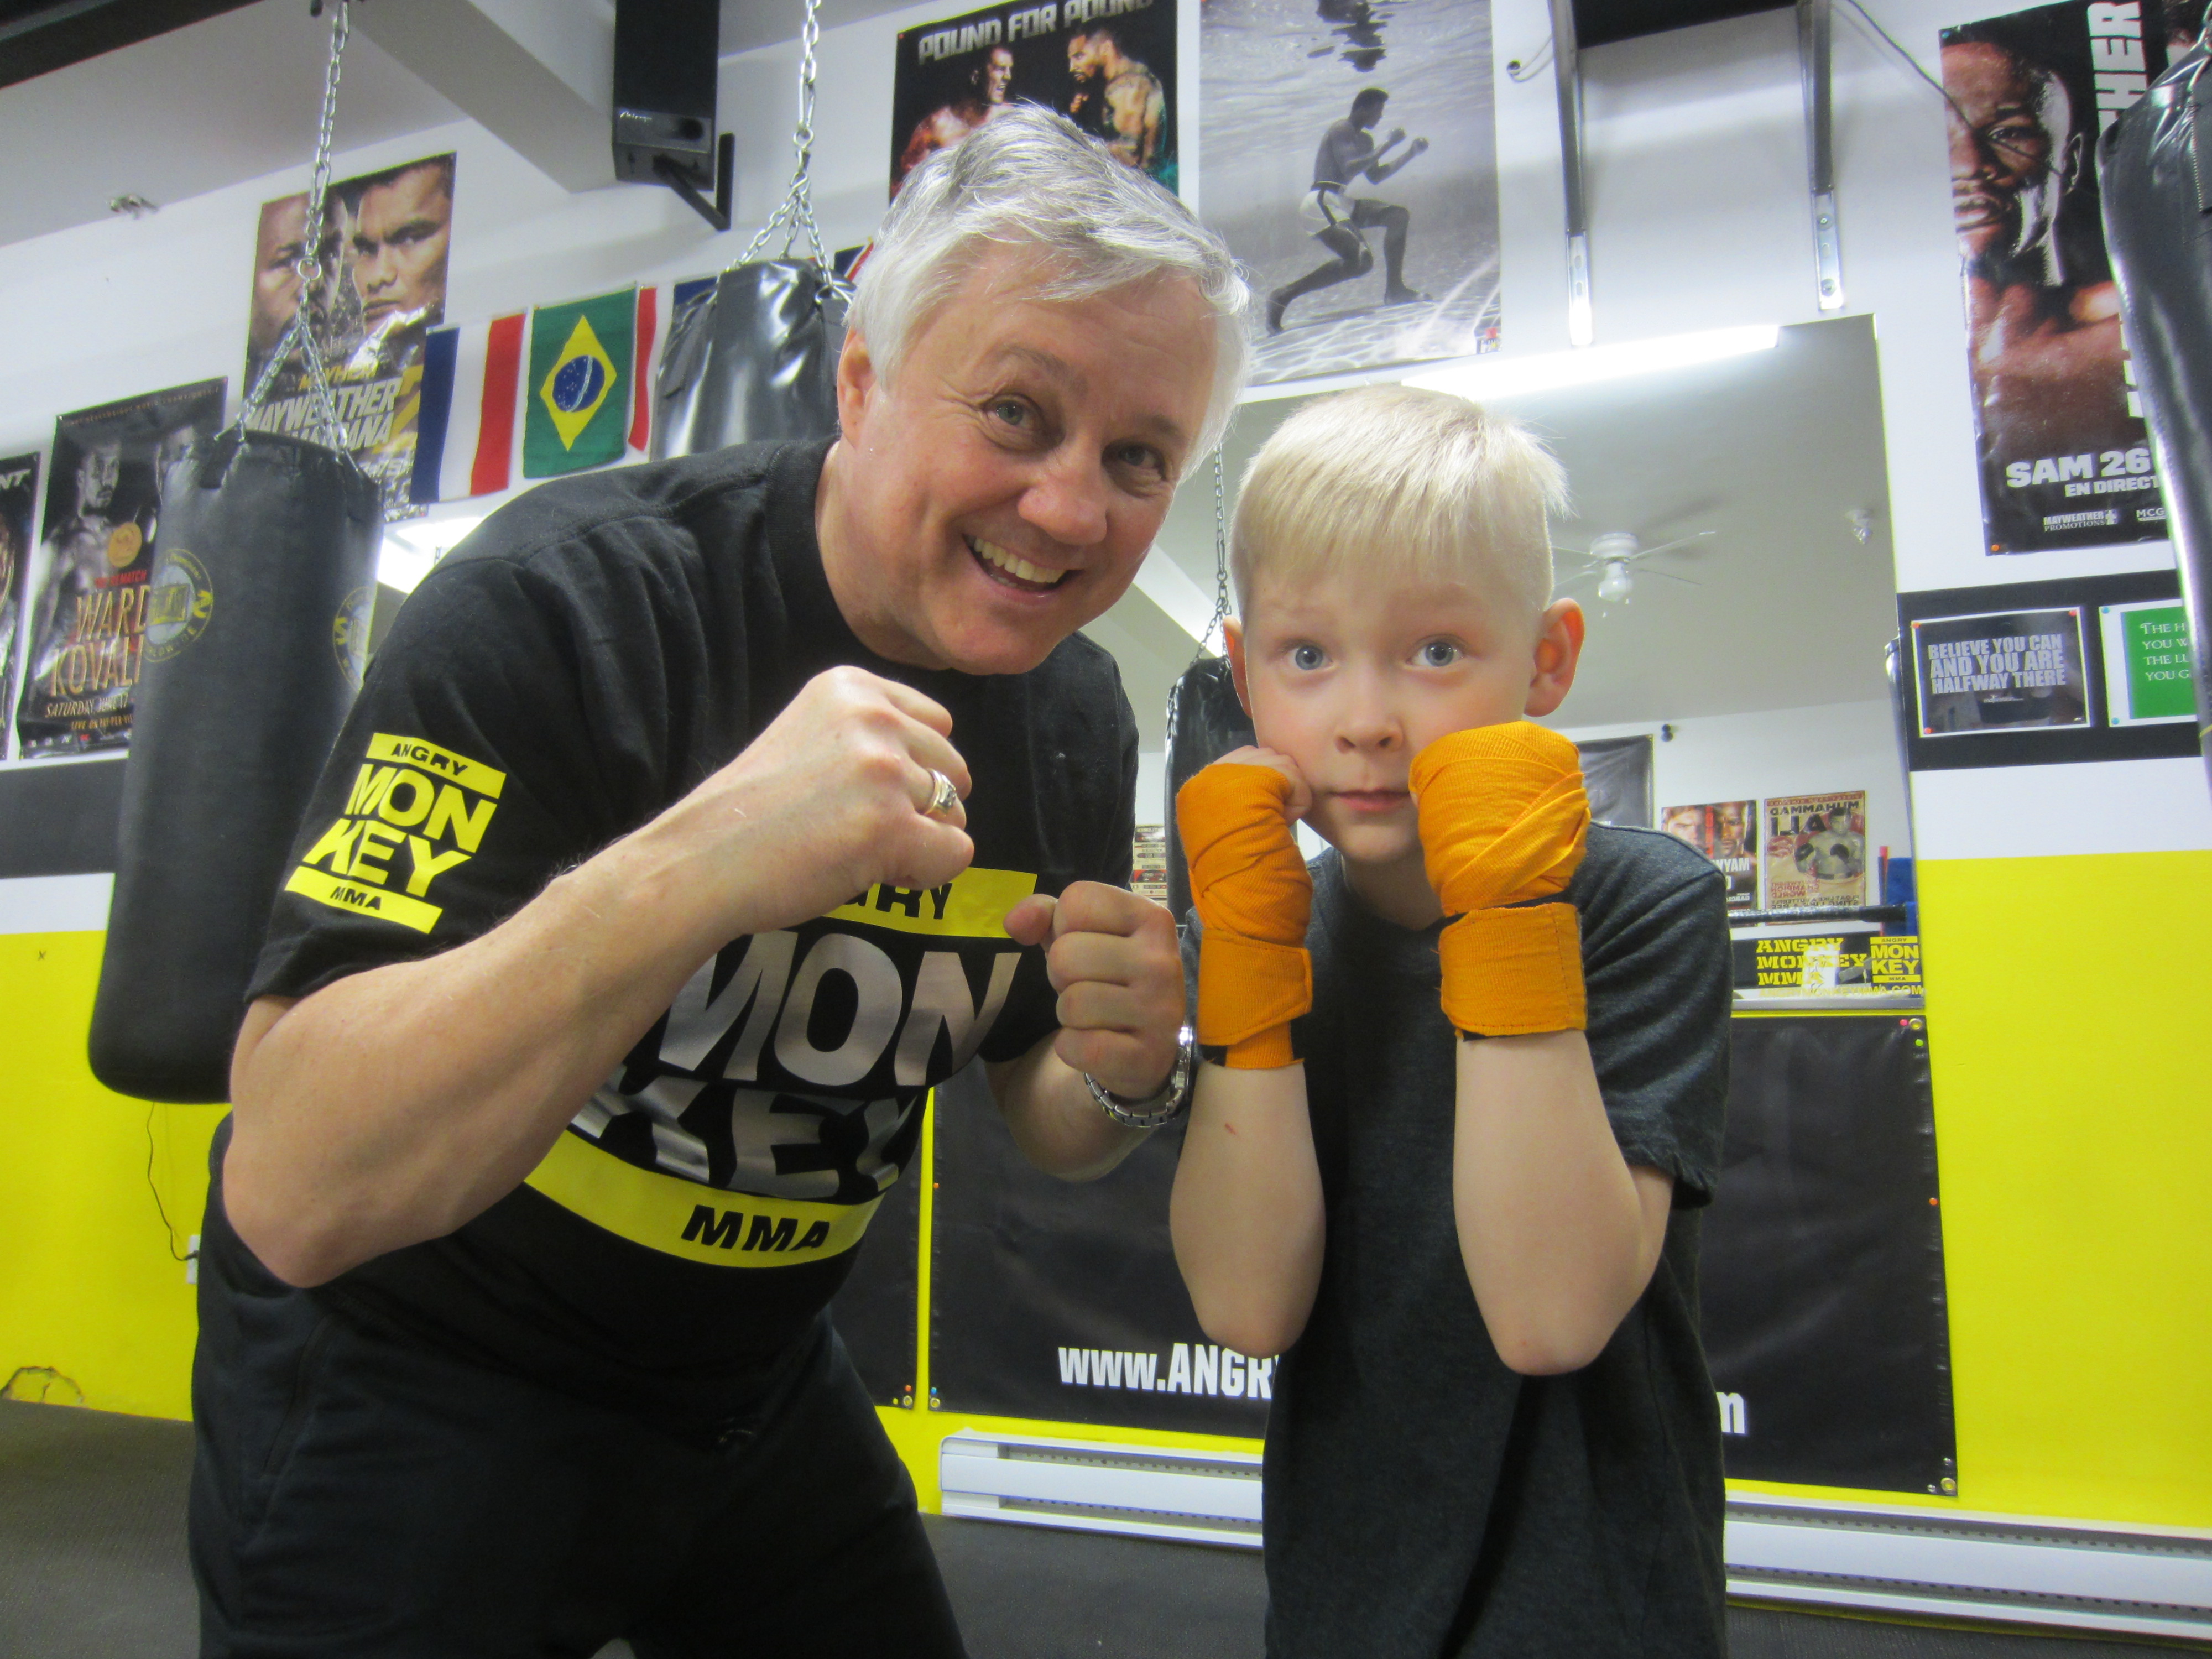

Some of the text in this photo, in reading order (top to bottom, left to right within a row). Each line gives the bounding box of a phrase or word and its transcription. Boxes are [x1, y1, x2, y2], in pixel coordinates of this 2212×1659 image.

[919, 19, 1001, 65] POUND
[1008, 5, 1057, 42] FOR
[2006, 448, 2150, 488] SAM 26
[2065, 482, 2091, 497] EN
[2043, 510, 2104, 525] MAYWEATHER
[2044, 519, 2106, 532] PROMOTIONS
[1928, 634, 2063, 660] BELIEVE YOU CAN
[2142, 639, 2172, 650] YOU
[1930, 649, 2065, 679] AND YOU ARE
[2143, 655, 2172, 665] THE
[1931, 669, 2067, 694] HALFWAY THERE
[2145, 670, 2176, 681] YOU
[391, 742, 468, 776] ANGRY
[344, 763, 498, 853] MON
[302, 818, 472, 898] KEY
[330, 886, 383, 911] MMA
[1756, 938, 1844, 953] ANGRY
[1870, 945, 1919, 959] MON
[1756, 954, 1867, 969] MONKEY
[1872, 959, 1919, 974] KEY
[1757, 972, 1824, 985] MMA
[1759, 985, 1923, 998] ANGRYMONKEYMMA.COM
[658, 929, 1022, 1087] MON
[567, 1061, 919, 1200] KEY
[681, 1204, 830, 1251] MMA
